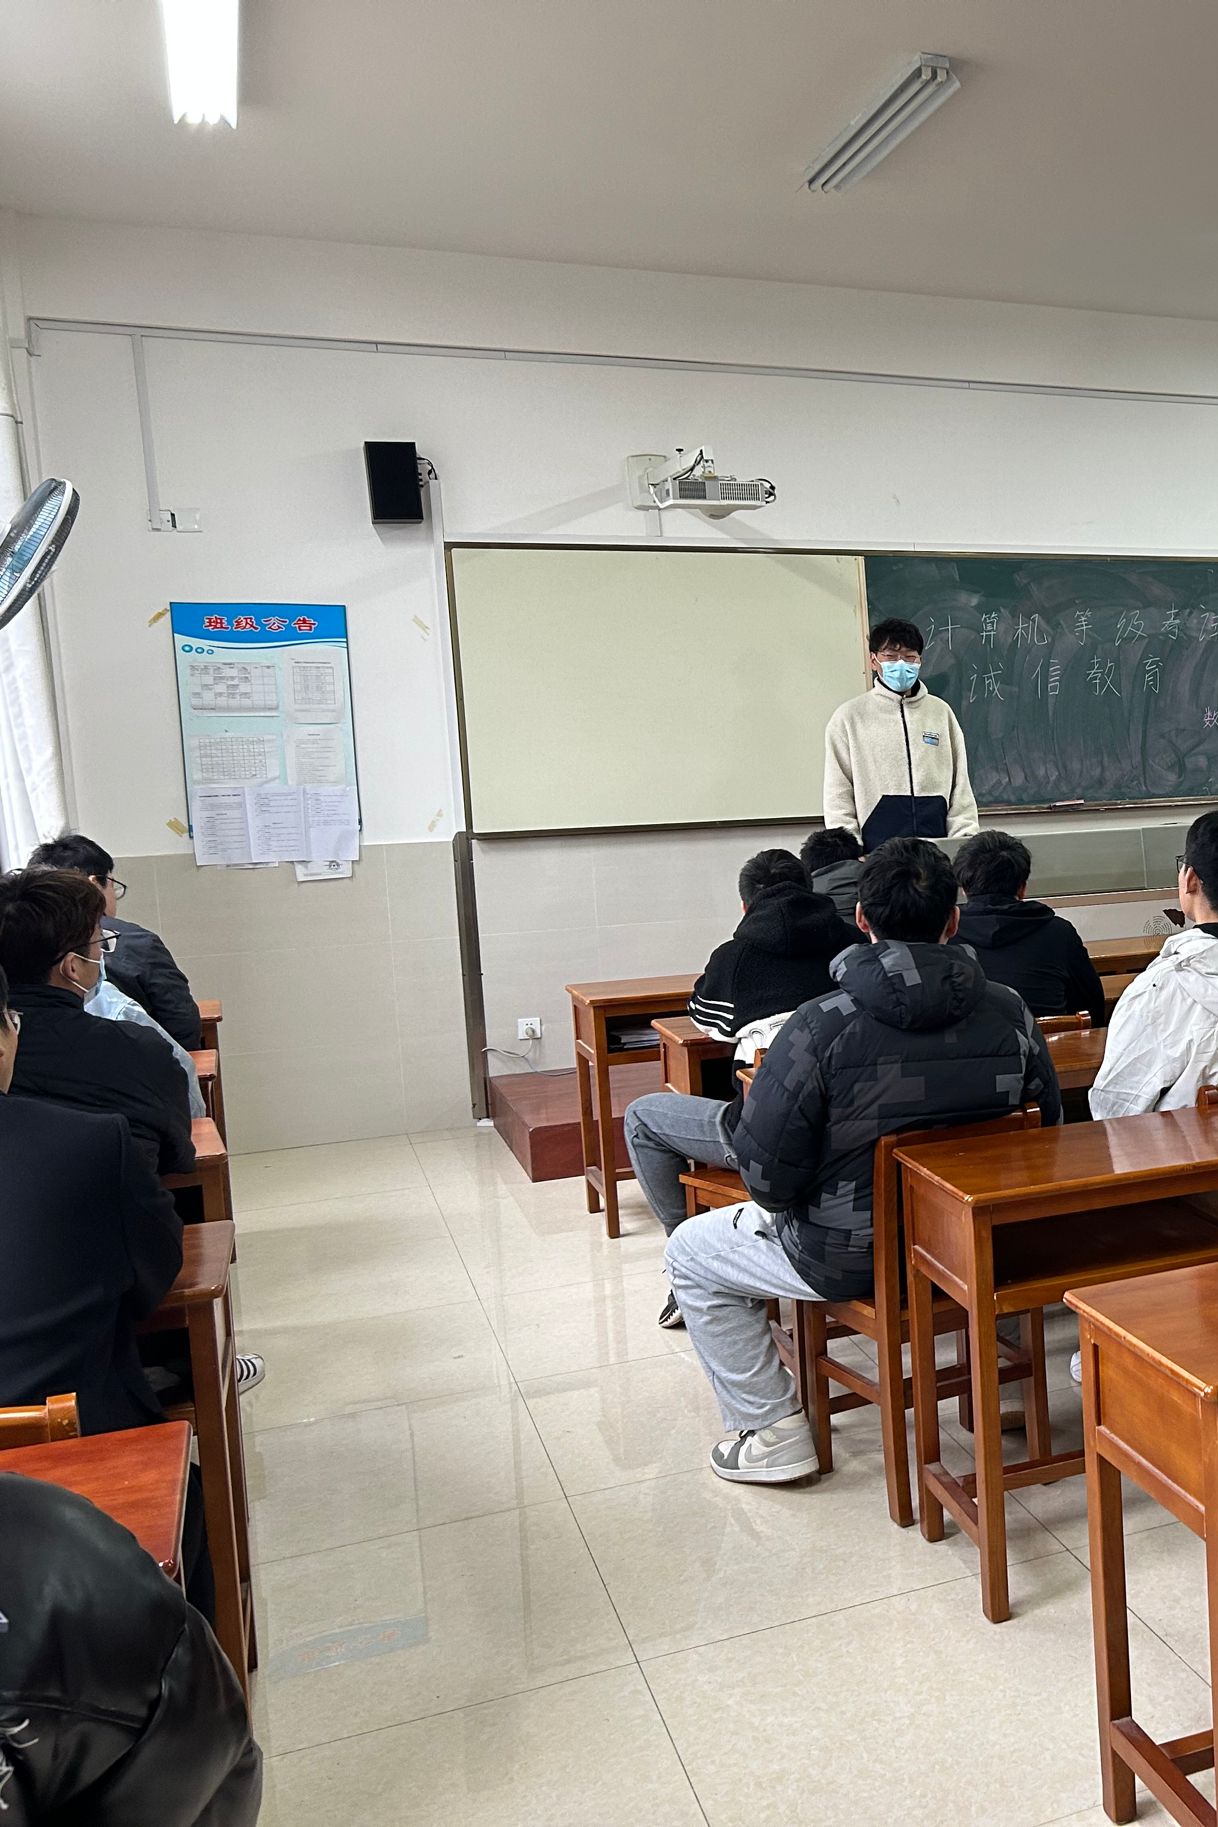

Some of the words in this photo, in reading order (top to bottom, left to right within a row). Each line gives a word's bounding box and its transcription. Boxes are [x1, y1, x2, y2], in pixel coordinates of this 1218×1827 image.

[203, 615, 318, 633] 班级公告
[969, 654, 1165, 703] 诚信教育
